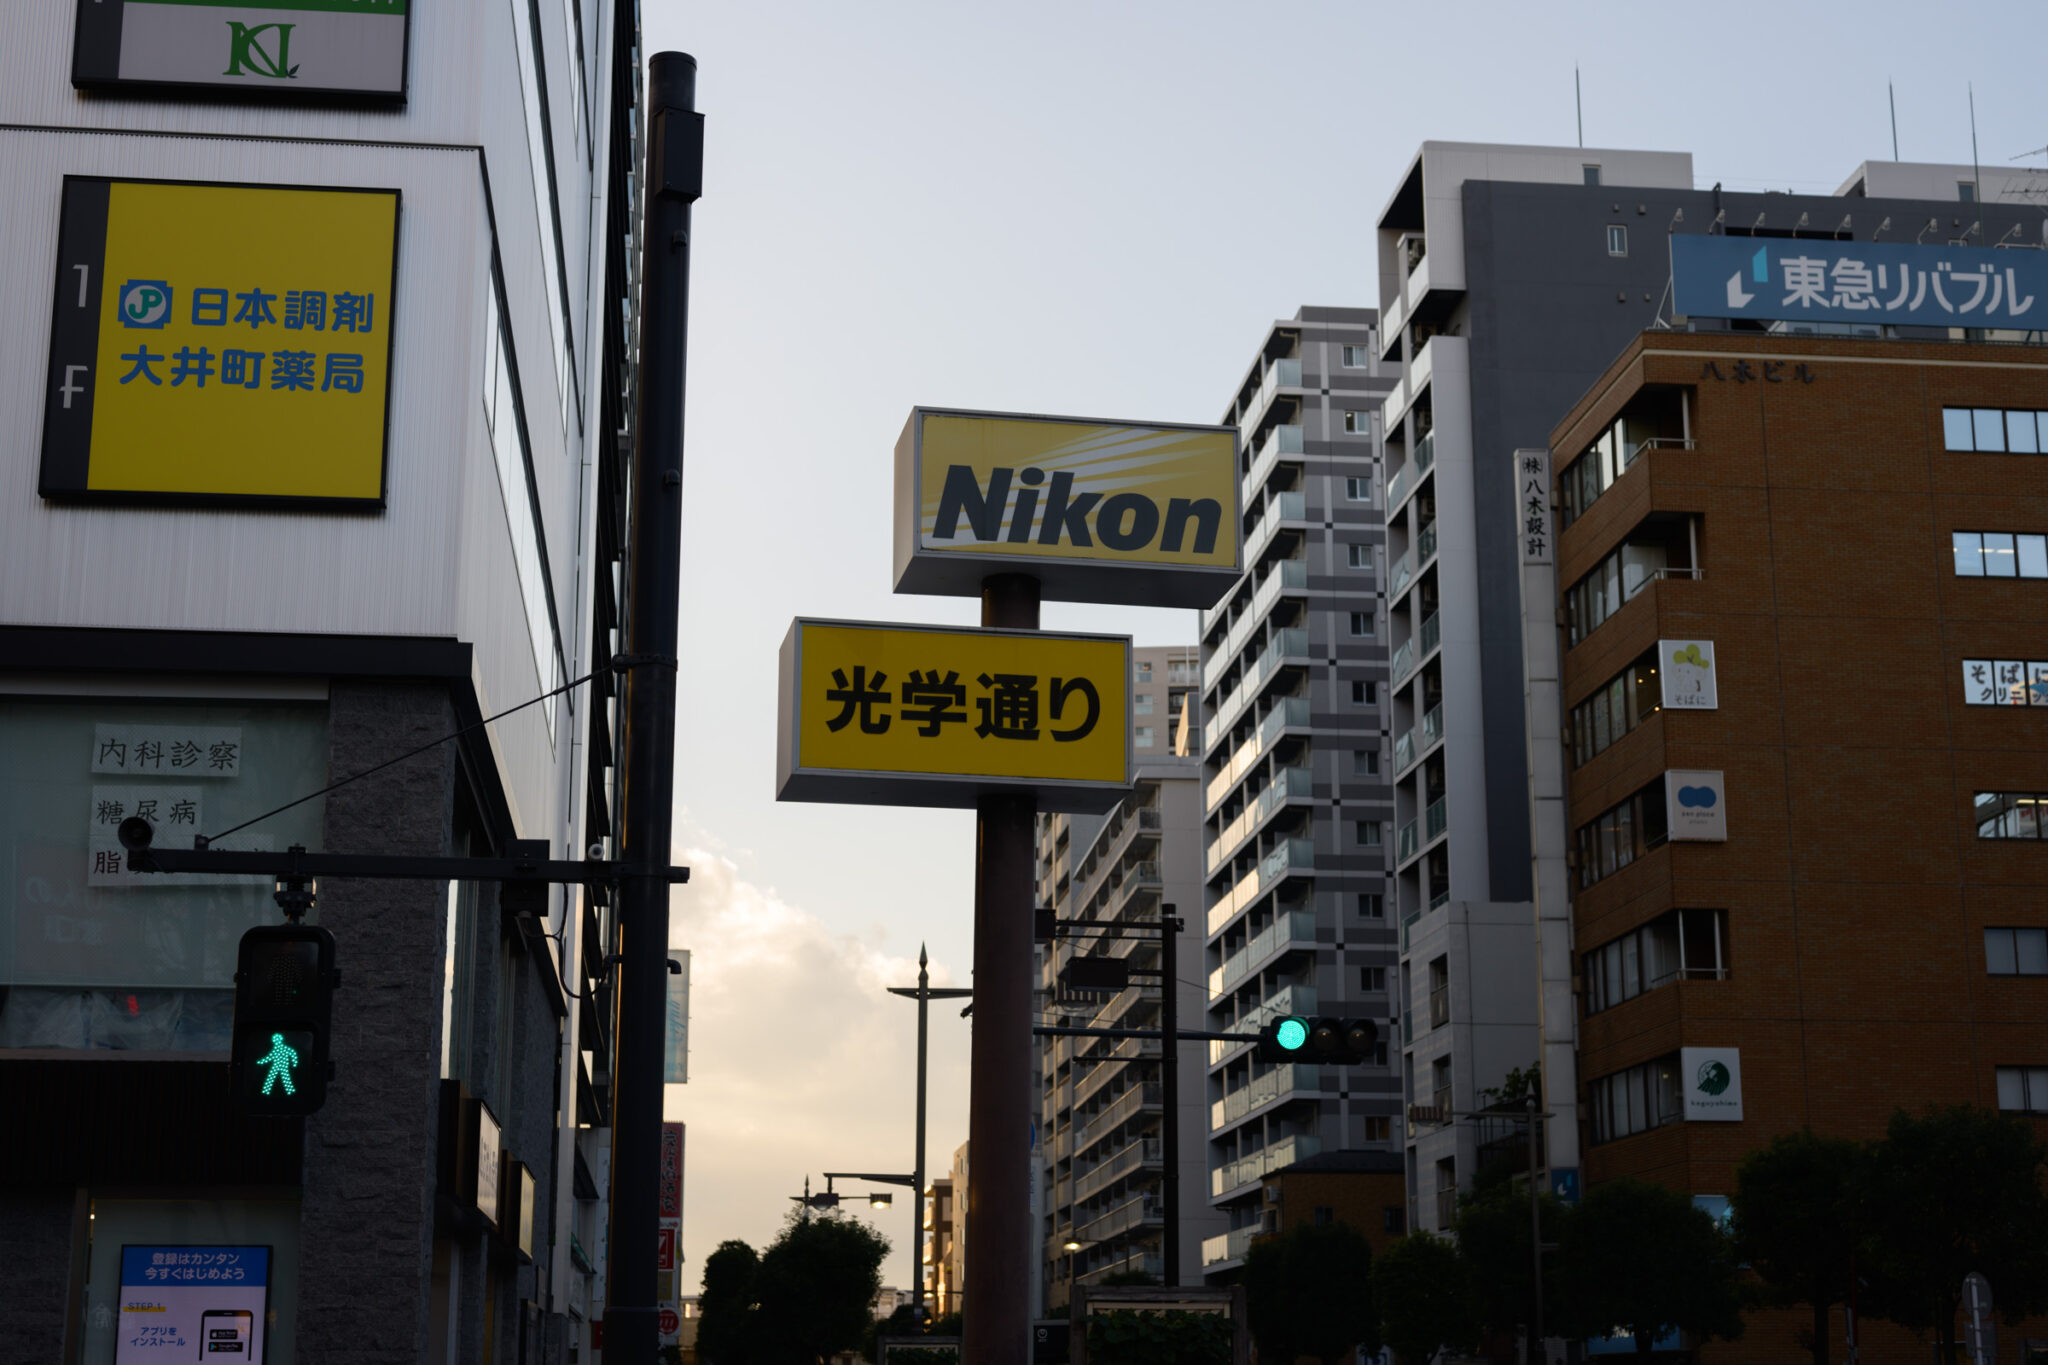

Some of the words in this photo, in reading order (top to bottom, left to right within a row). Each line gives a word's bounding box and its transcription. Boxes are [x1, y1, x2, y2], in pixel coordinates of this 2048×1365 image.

[1779, 255, 2035, 317] 東急リバブル
[191, 287, 374, 333] 日本調剤
[118, 344, 366, 394] 大井町薬局
[1699, 359, 1816, 384] 八木ビル
[932, 463, 1223, 555] Nikon
[825, 665, 1101, 742] 光学通り
[1674, 694, 1707, 705] そばに
[98, 737, 239, 772] 内科診察
[97, 799, 198, 825] 糖尿病
[152, 1252, 240, 1265] 登録はカンタン
[145, 1267, 245, 1280] 今すぐはじめよう
[130, 1338, 186, 1347] インストール
[141, 1327, 177, 1336] アプリを
